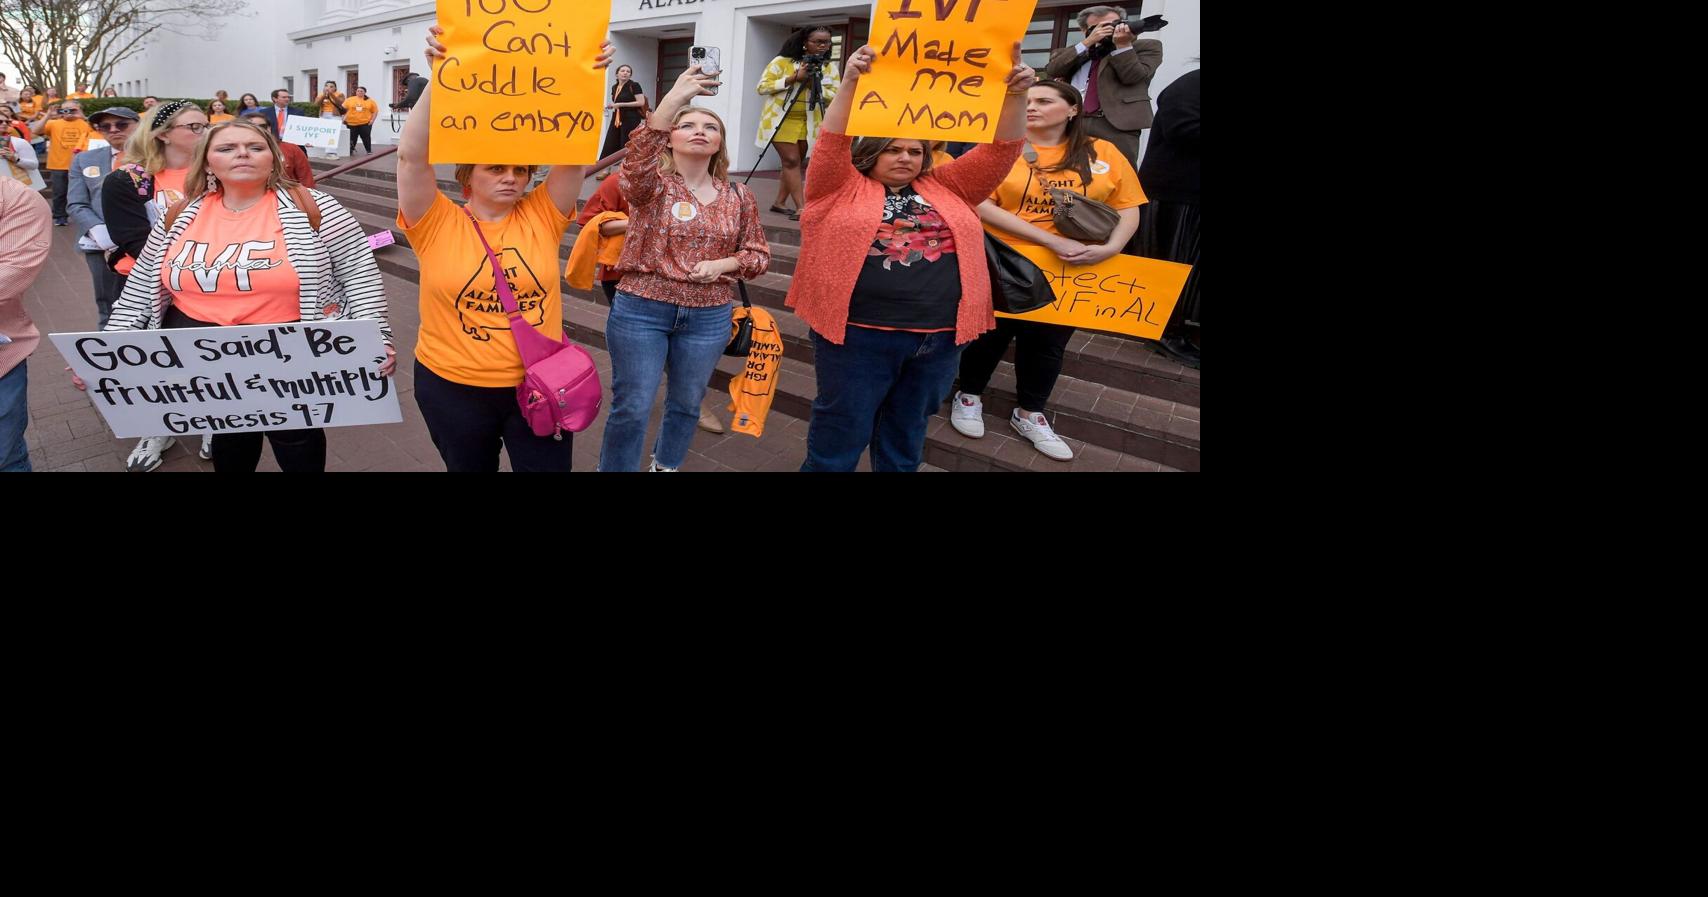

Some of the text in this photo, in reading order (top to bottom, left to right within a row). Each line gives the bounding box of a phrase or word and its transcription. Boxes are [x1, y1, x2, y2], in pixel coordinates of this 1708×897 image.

[881, 28, 992, 68] Made
[437, 57, 561, 96] Cuddle
[910, 68, 985, 97] me
[859, 91, 888, 110] A
[295, 125, 337, 134] SUPPORT
[440, 110, 595, 138] an embryo
[168, 239, 276, 293] IVF
[1042, 264, 1146, 293] otect
[1119, 296, 1160, 326] AL
[75, 336, 185, 371] God
[94, 372, 243, 406] fruitful
[244, 373, 268, 393] &
[162, 408, 288, 434] Genesis
